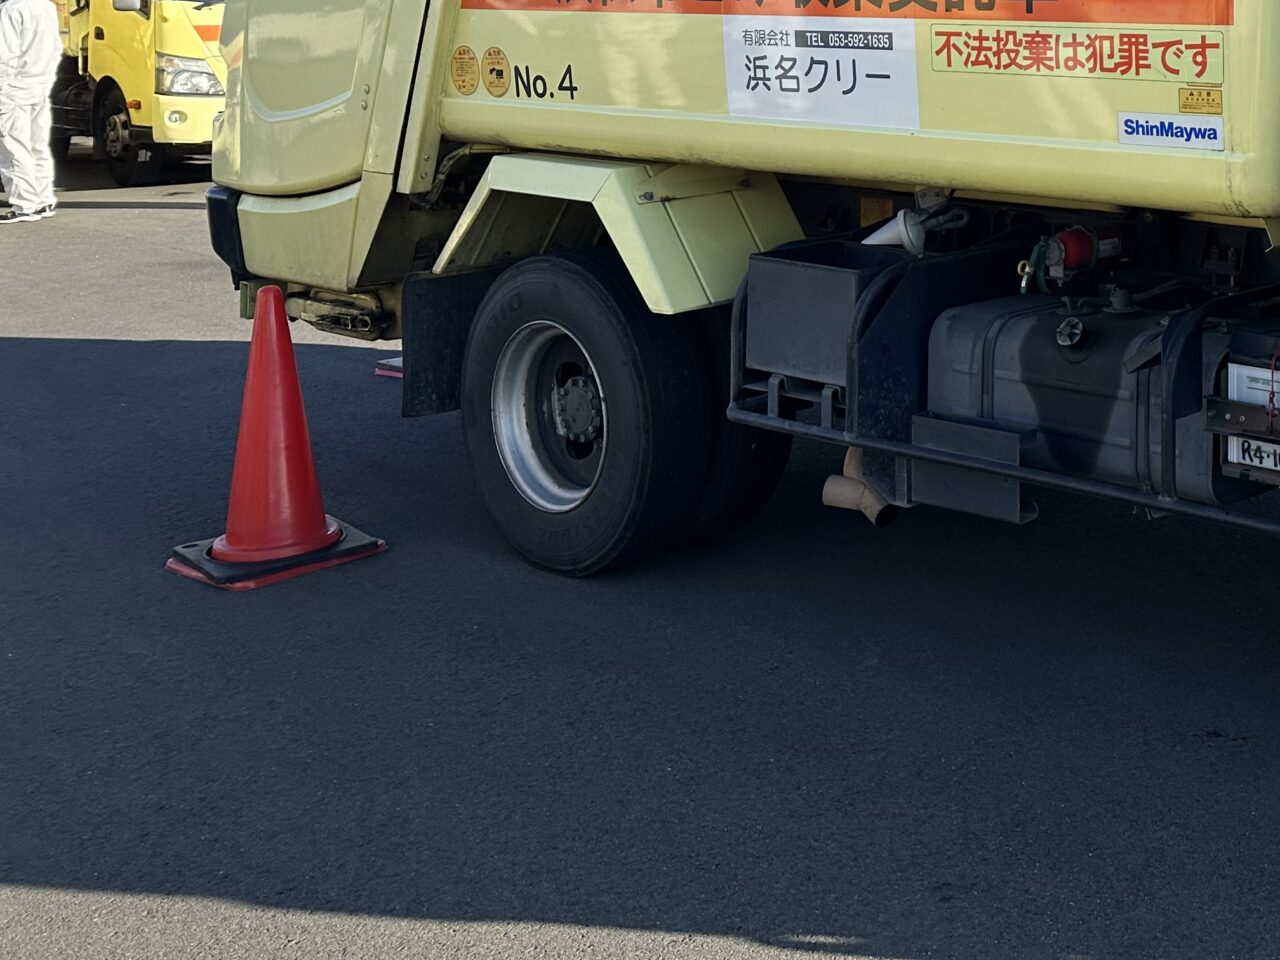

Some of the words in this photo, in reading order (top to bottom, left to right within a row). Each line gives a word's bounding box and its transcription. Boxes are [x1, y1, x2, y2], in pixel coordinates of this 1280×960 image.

[742, 29, 792, 47] 有限会社
[805, 32, 825, 47] TEL
[828, 33, 890, 49] 053-592-1635
[934, 28, 1221, 79] 不法投棄は犯罪です
[513, 63, 579, 101] No.4
[744, 54, 892, 96] 浜名クリー
[1123, 118, 1219, 142] ShinMaywa
